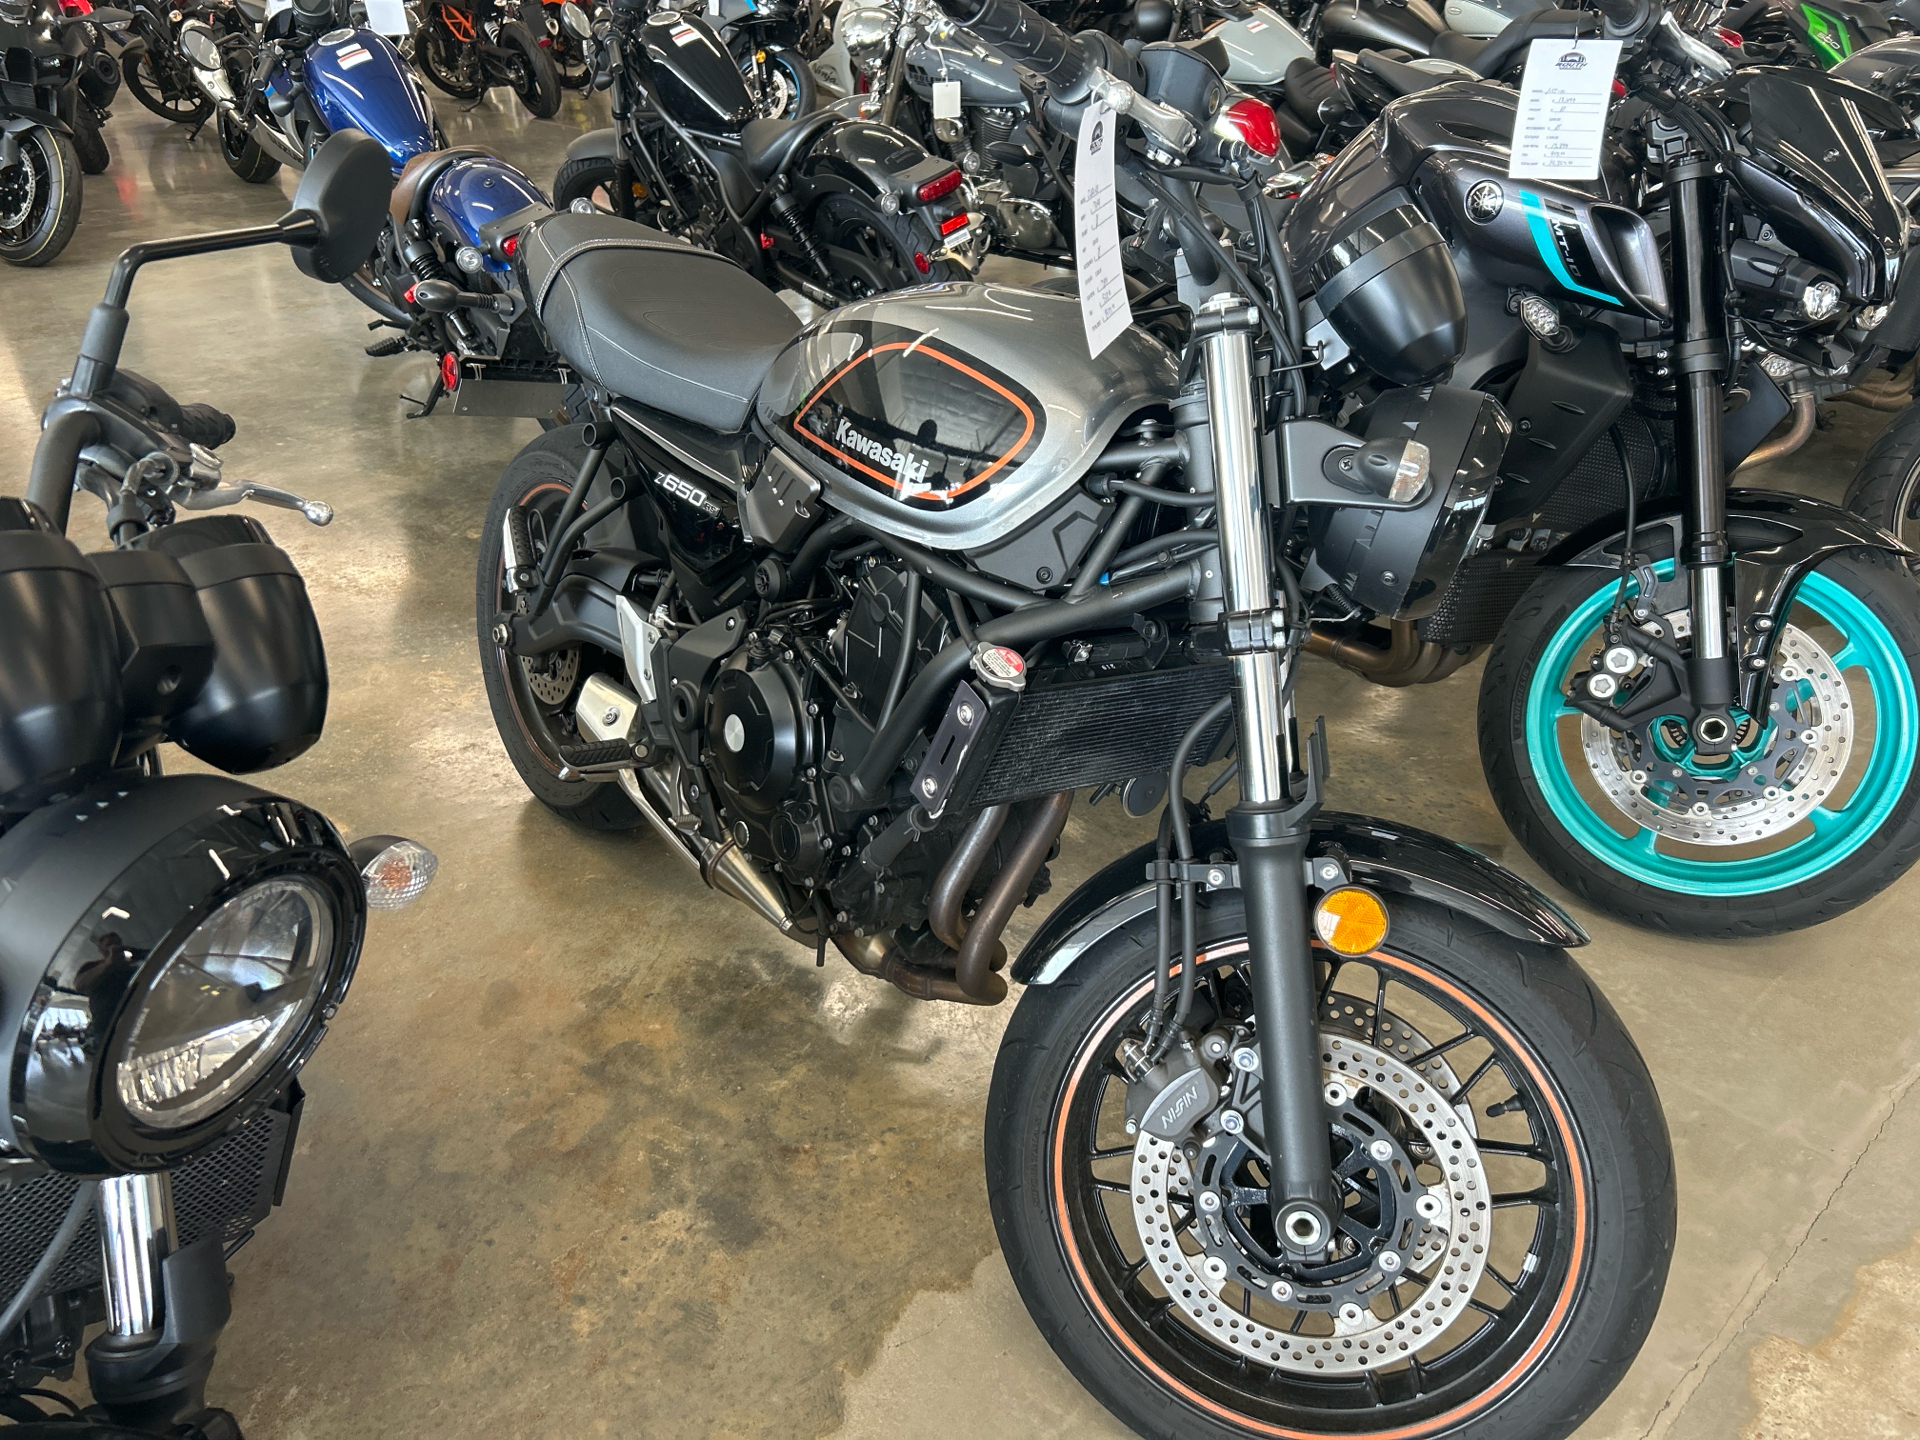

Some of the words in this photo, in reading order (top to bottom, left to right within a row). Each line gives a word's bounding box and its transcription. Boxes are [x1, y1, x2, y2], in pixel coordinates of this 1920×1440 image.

[812, 63, 838, 84] Ninja
[1551, 218, 1582, 277] MT-10
[835, 418, 930, 483] Kawasaki
[1513, 667, 1528, 720] MICHELIN
[1161, 1085, 1198, 1130] NISSIN
[1028, 1115, 1041, 1208] SPORTMAX
